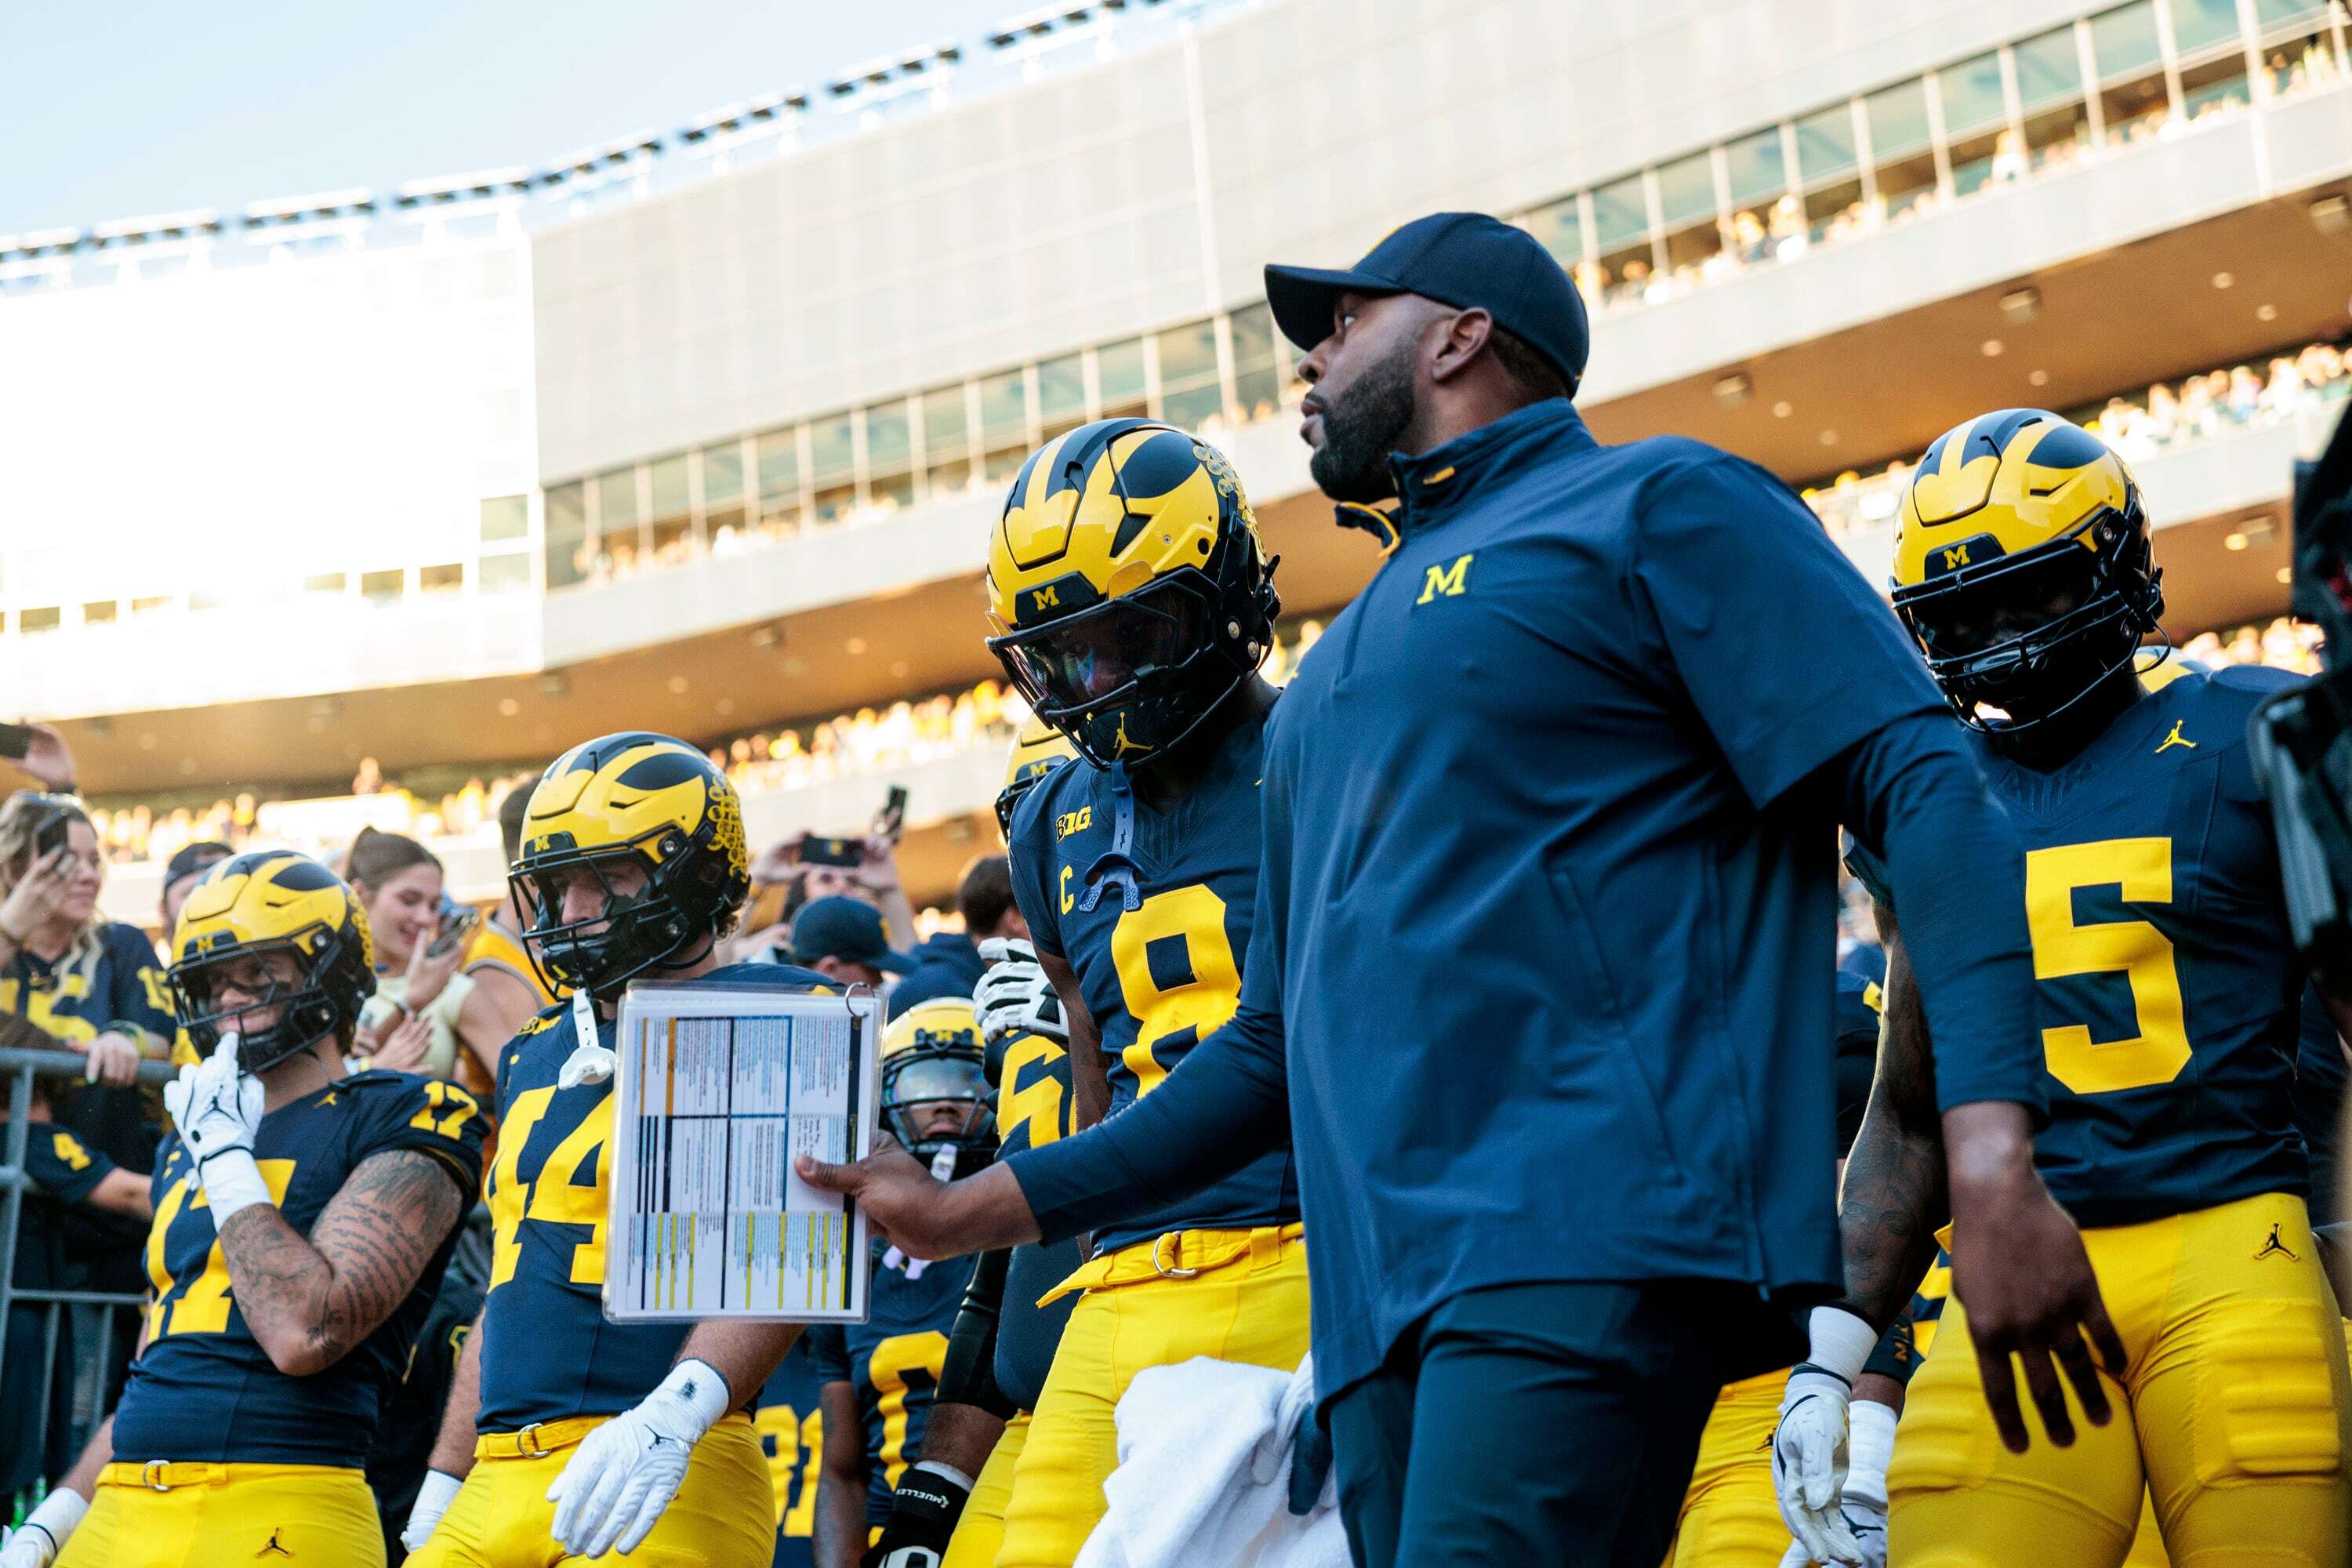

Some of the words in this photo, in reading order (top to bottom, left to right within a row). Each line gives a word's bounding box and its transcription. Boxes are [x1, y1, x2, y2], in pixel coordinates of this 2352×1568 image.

[1417, 554, 1473, 605] M
[1944, 544, 1970, 570] M
[1032, 585, 1060, 612] M
[1060, 865, 1074, 916] C
[1112, 884, 1242, 1099] 8
[2025, 837, 2193, 1095] 5
[409, 1081, 478, 1142] 17
[53, 1133, 91, 1171] 4
